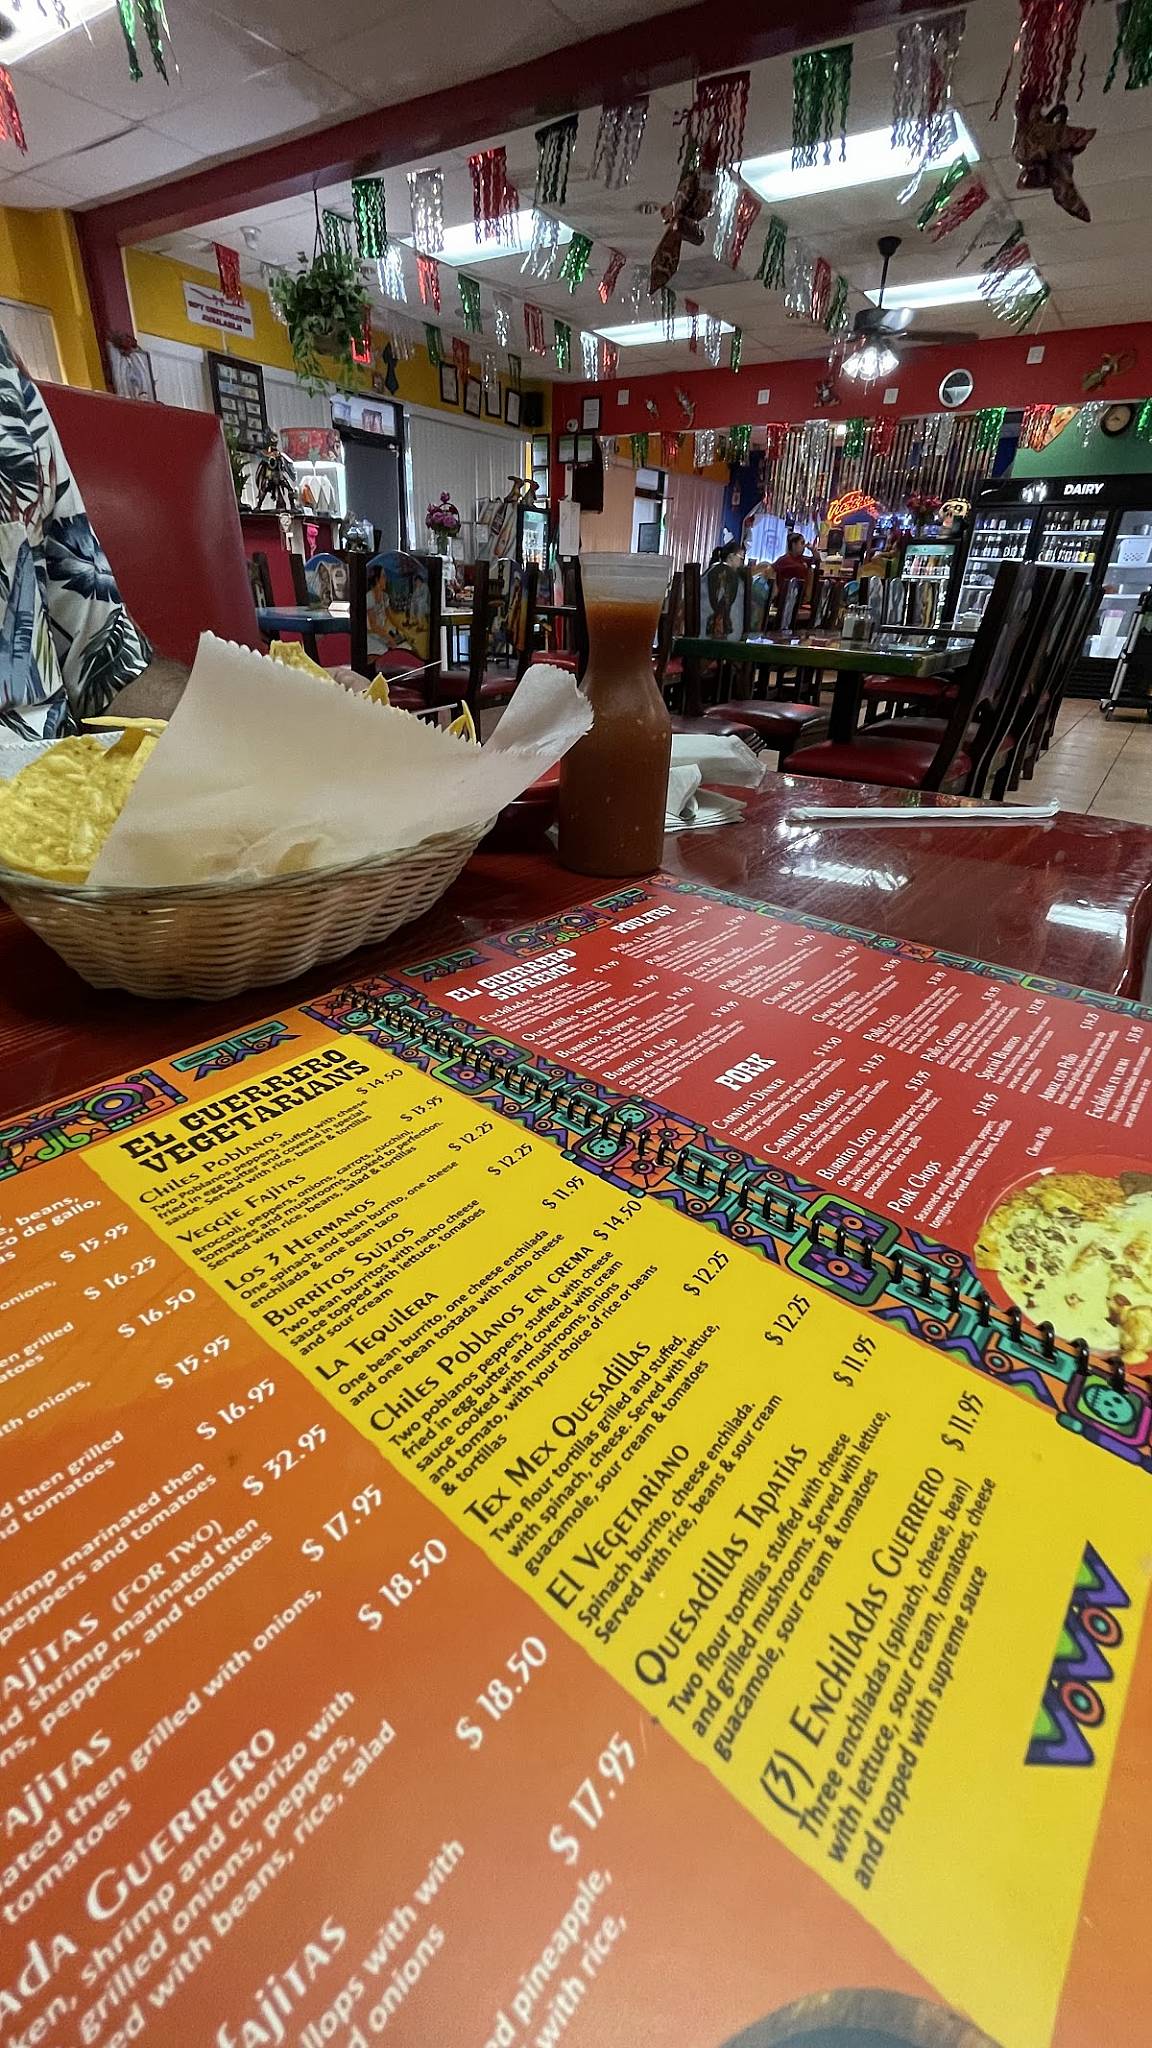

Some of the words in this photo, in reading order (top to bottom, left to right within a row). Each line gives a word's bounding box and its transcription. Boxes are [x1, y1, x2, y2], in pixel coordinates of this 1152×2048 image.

[1063, 483, 1105, 496] DAIRY
[610, 905, 676, 933] POULTRY
[445, 987, 482, 1001] EL
[477, 948, 576, 988] GUERRERO
[488, 963, 576, 1000] SUPREME
[119, 1131, 176, 1158] EL
[179, 1050, 347, 1130] GUERRERO
[138, 1060, 369, 1172] VEGETARIANS
[356, 1086, 367, 1095] $
[367, 1069, 402, 1088] 14.50
[400, 1112, 412, 1122] $
[411, 1096, 442, 1114] 13.95
[714, 1053, 776, 1090] PORK
[150, 1198, 177, 1211] Two
[178, 1171, 231, 1198] Poblanos
[233, 1148, 279, 1172] peppers,
[279, 1127, 313, 1147] stuffed
[314, 1117, 336, 1128] with
[337, 1100, 367, 1116] cheese
[448, 1141, 461, 1152] $
[459, 1121, 493, 1143] 12.25
[15, 1197, 79, 1226] beans,
[22, 1222, 48, 1238] de
[51, 1200, 101, 1226] gallo,
[60, 1249, 75, 1263] $
[79, 1223, 128, 1252] 15.95
[240, 1282, 268, 1299] One
[269, 1252, 316, 1282] spinach
[317, 1236, 339, 1252] and
[337, 1220, 367, 1238] bean
[366, 1196, 407, 1220] burrito,
[407, 1182, 426, 1195] one
[426, 1161, 458, 1182] cheese
[250, 1269, 310, 1308] enchilada
[310, 1261, 323, 1269] &
[324, 1246, 346, 1261] one
[345, 1228, 375, 1246] bean
[374, 1212, 398, 1227] taco
[118, 1322, 135, 1338] $
[138, 1289, 195, 1325] 16.50
[279, 1317, 308, 1336] Two
[308, 1295, 342, 1317] bean
[340, 1263, 388, 1295] burritos
[388, 1245, 414, 1262] with
[414, 1223, 445, 1245] nacho
[446, 1200, 479, 1223] cheese
[338, 1372, 368, 1394] One
[366, 1347, 401, 1372] bean
[398, 1314, 446, 1346] burrito,
[446, 1294, 468, 1312] one
[468, 1266, 504, 1294] cheese
[503, 1230, 548, 1266] enchilada
[243, 1474, 263, 1496] $
[263, 1424, 326, 1479] 32.95
[490, 1512, 523, 1541] Two
[520, 1476, 553, 1511] flour
[552, 1430, 599, 1477] tortillas
[597, 1391, 632, 1432] grilled
[629, 1370, 651, 1394] and
[649, 1335, 686, 1373] stuffed,
[508, 1523, 541, 1556] with
[540, 1471, 592, 1523] spinach,
[590, 1425, 632, 1467] cheese.
[627, 1380, 665, 1422] Served
[662, 1359, 687, 1383] with
[680, 1325, 720, 1359] lettuce,
[941, 1432, 964, 1452] $
[948, 1390, 983, 1434] 11.95
[17, 1472, 63, 1504] then
[67, 1430, 124, 1475] grilled
[91, 1537, 128, 1572] and
[130, 1474, 216, 1539] tomatoes
[112, 1562, 164, 1612] (FOR
[166, 1519, 222, 1562] TWO)
[595, 1580, 644, 1644] Served
[640, 1547, 671, 1582] with
[668, 1518, 697, 1547] rice,
[688, 1472, 725, 1514] beans
[719, 1459, 736, 1472] &
[731, 1430, 755, 1460] sour
[752, 1395, 782, 1430] cream
[28, 1641, 108, 1710] shrimp
[112, 1551, 214, 1641] marinated
[215, 1519, 258, 1554] then
[692, 1690, 721, 1737] and
[717, 1629, 757, 1698] grilled
[752, 1538, 815, 1633] mushrooms.
[807, 1482, 844, 1534] Served
[838, 1454, 862, 1483] with
[852, 1411, 891, 1454] lettuce,
[67, 1767, 126, 1824] then
[131, 1692, 201, 1771] grilled
[203, 1650, 251, 1696] with
[253, 1590, 321, 1650] onions,
[456, 1715, 483, 1750] $
[477, 1636, 546, 1720] 18.50
[855, 1830, 884, 1890] and
[873, 1743, 917, 1834] topped
[908, 1698, 937, 1747] with
[928, 1615, 969, 1697] supreme
[960, 1566, 987, 1615] sauce
[549, 1823, 579, 1864] $
[569, 1732, 635, 1827] 17.95
[760, 1749, 814, 1817] (3)
[81, 1882, 174, 1985] shrimp
[180, 1825, 225, 1882] and
[229, 1741, 307, 1828] chorizo
[307, 1691, 354, 1740] with
[150, 1936, 211, 2009] with
[212, 1850, 294, 1936] beans,
[294, 1794, 343, 1844] rice,
[343, 1719, 396, 1786] salad
[79, 1929, 167, 2048] grilled
[173, 1840, 262, 1934] onions,
[263, 1736, 355, 1838] peppers,
[363, 1905, 416, 1974] with
[415, 1840, 464, 1904] with
[512, 1870, 612, 2027] pineapple,
